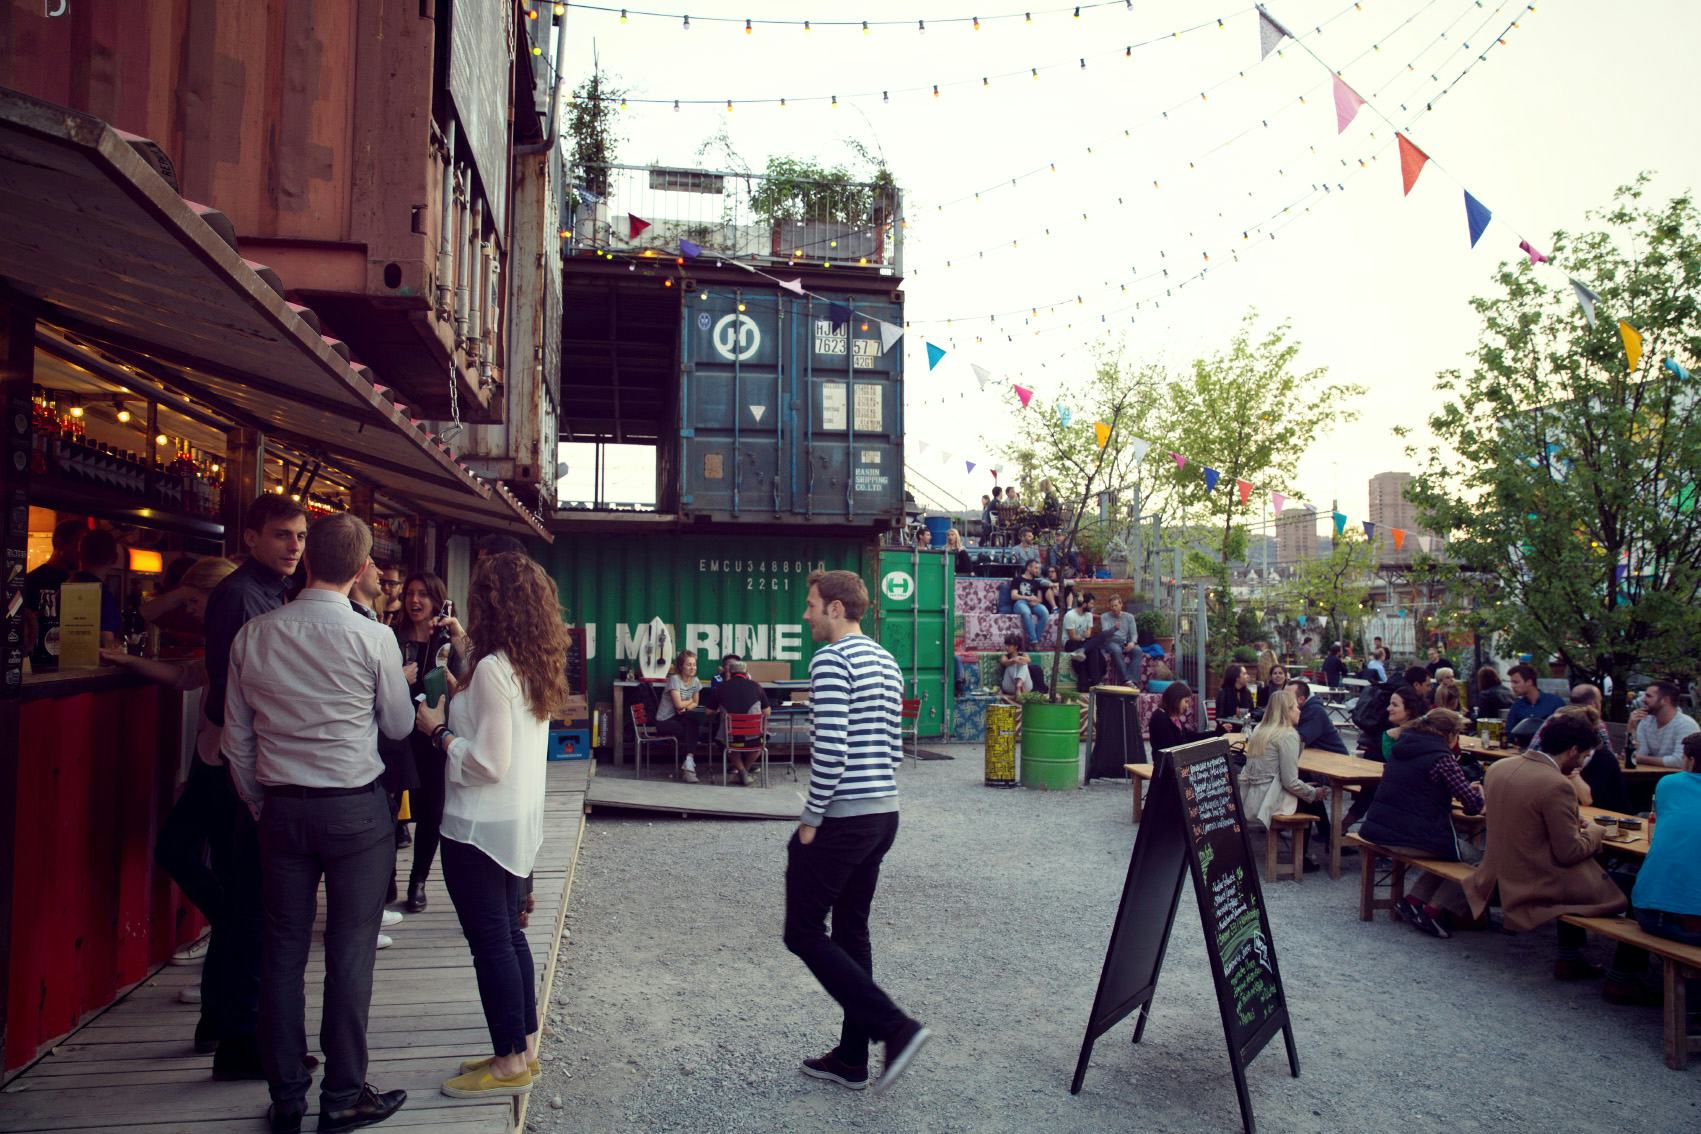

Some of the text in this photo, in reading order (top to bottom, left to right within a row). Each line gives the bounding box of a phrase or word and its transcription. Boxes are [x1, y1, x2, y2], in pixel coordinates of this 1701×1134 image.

[816, 338, 846, 353] 7623
[854, 340, 868, 354] 57
[855, 476, 888, 484] SHIPPING
[747, 578, 789, 591] 22G1
[888, 578, 909, 593] H
[615, 623, 802, 661] MRINE
